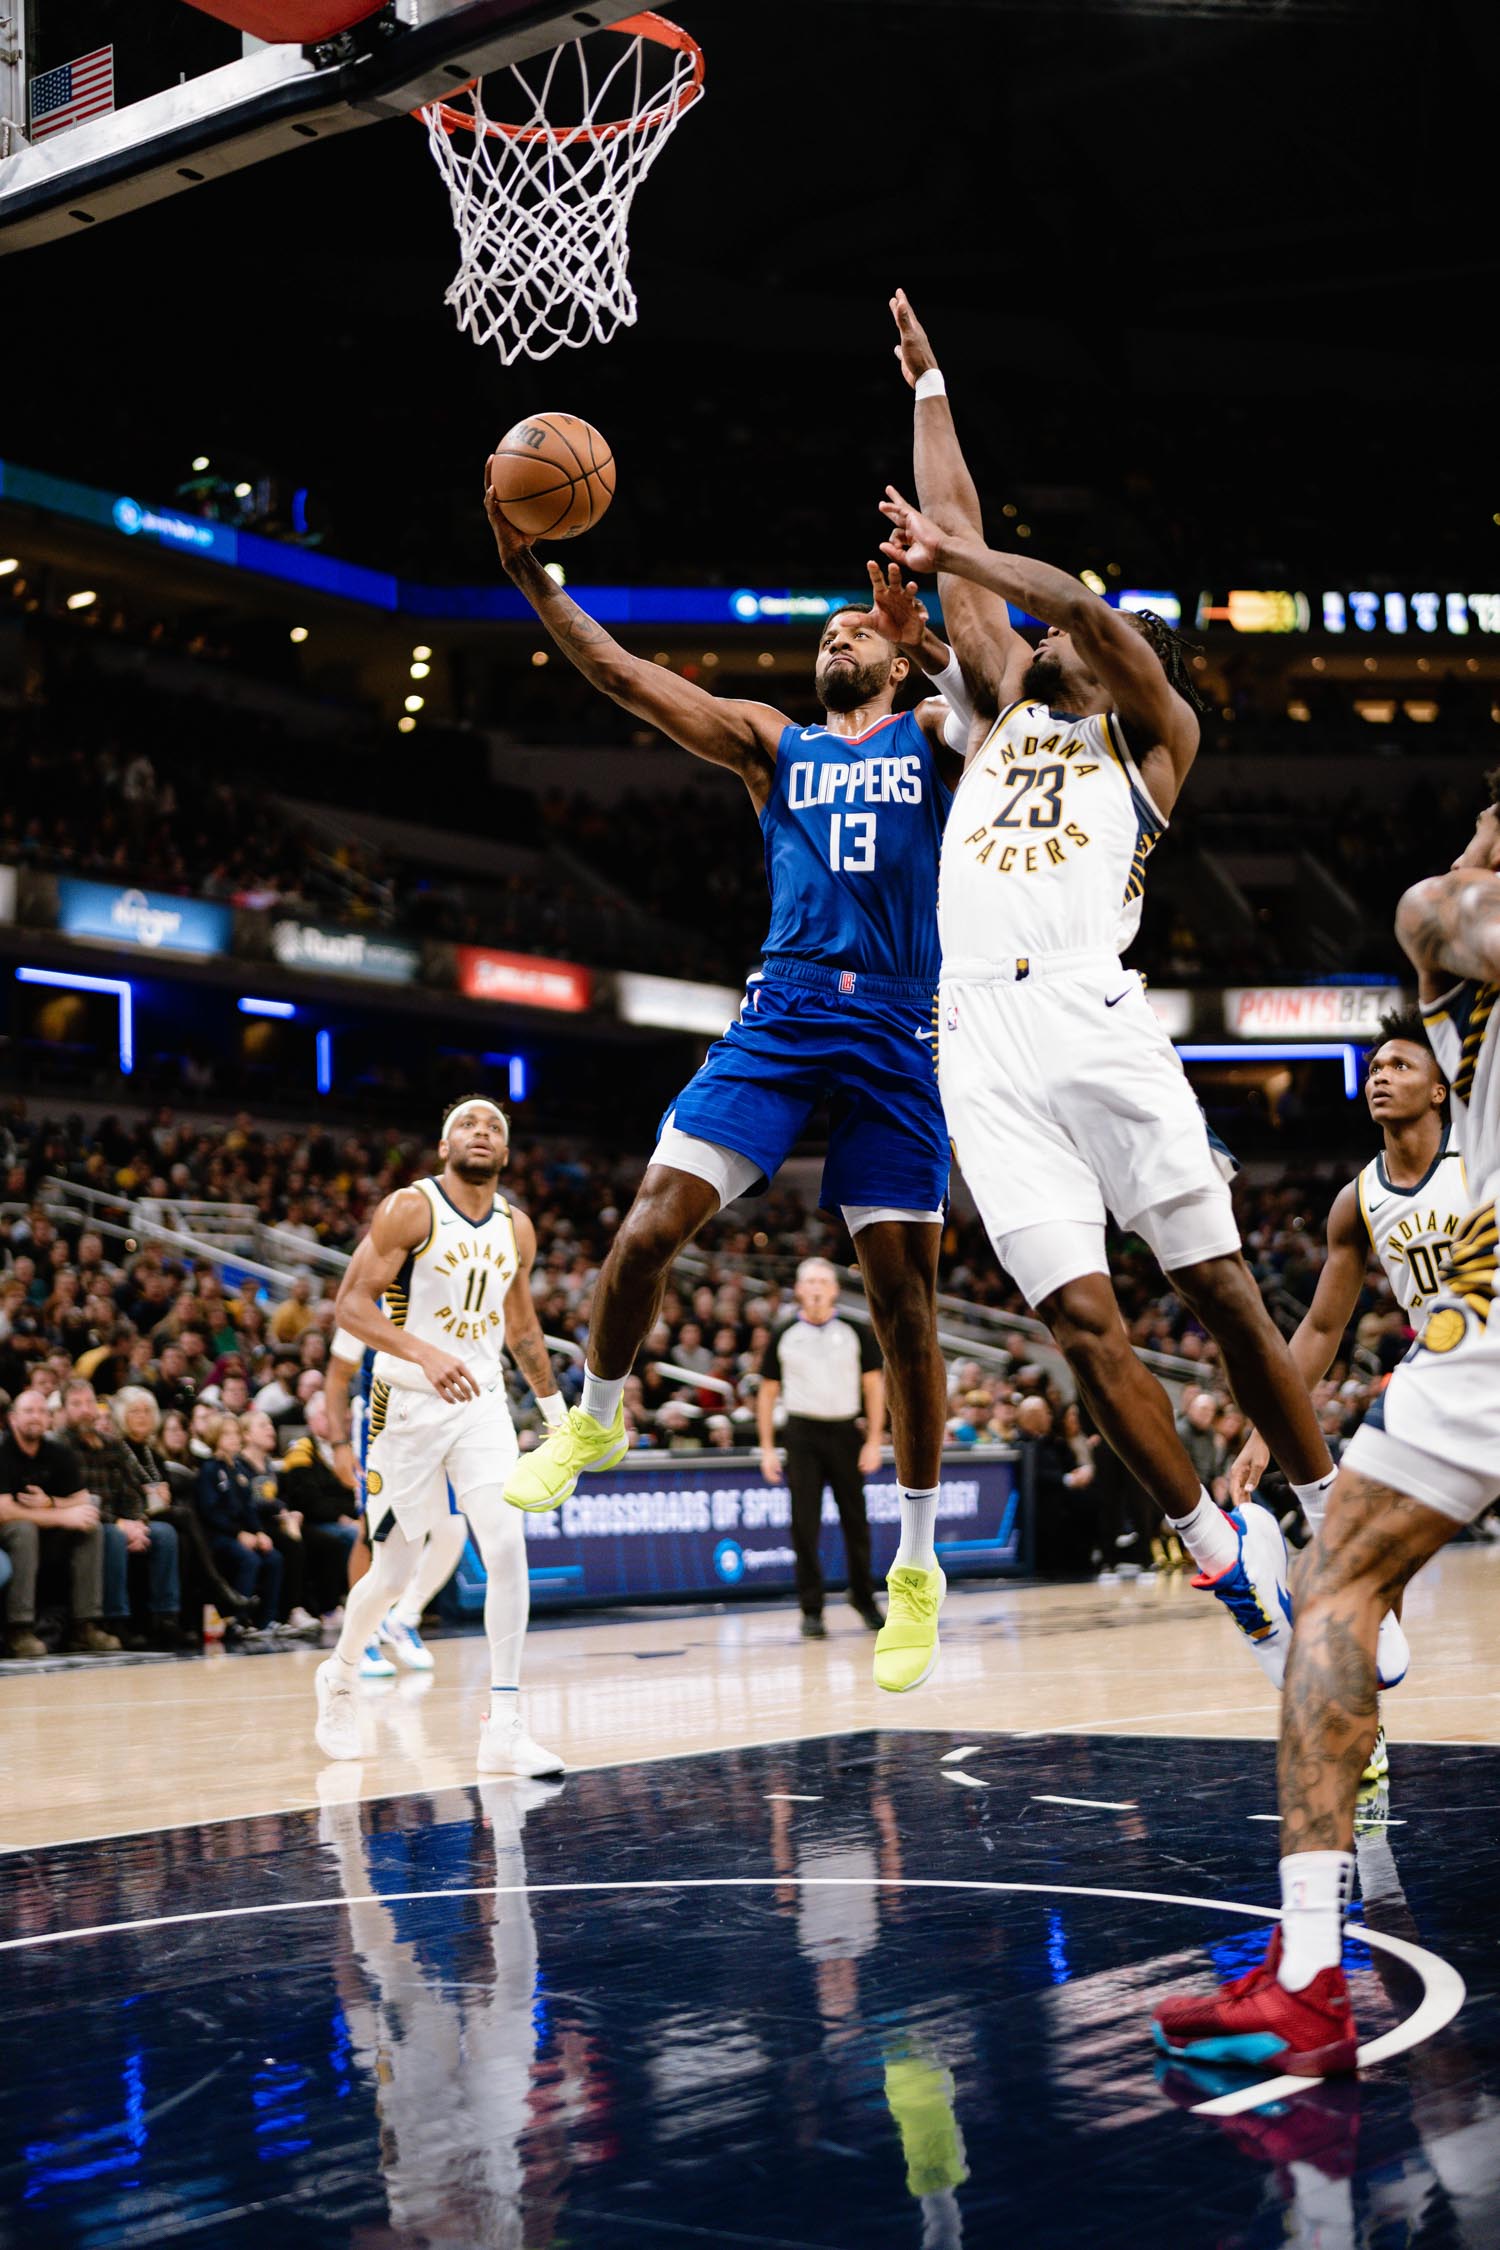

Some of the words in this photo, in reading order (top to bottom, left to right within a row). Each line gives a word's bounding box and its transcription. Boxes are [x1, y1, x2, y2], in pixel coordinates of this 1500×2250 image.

[985, 734, 1100, 778] INDANA
[788, 755, 922, 810] CLIPPERS
[991, 764, 1065, 829] 23
[829, 812, 877, 872] 13
[964, 822, 1090, 872] PACERS
[433, 1240, 512, 1281] INDIANA
[1387, 1209, 1460, 1265] INDIAN
[463, 1267, 488, 1312] 11
